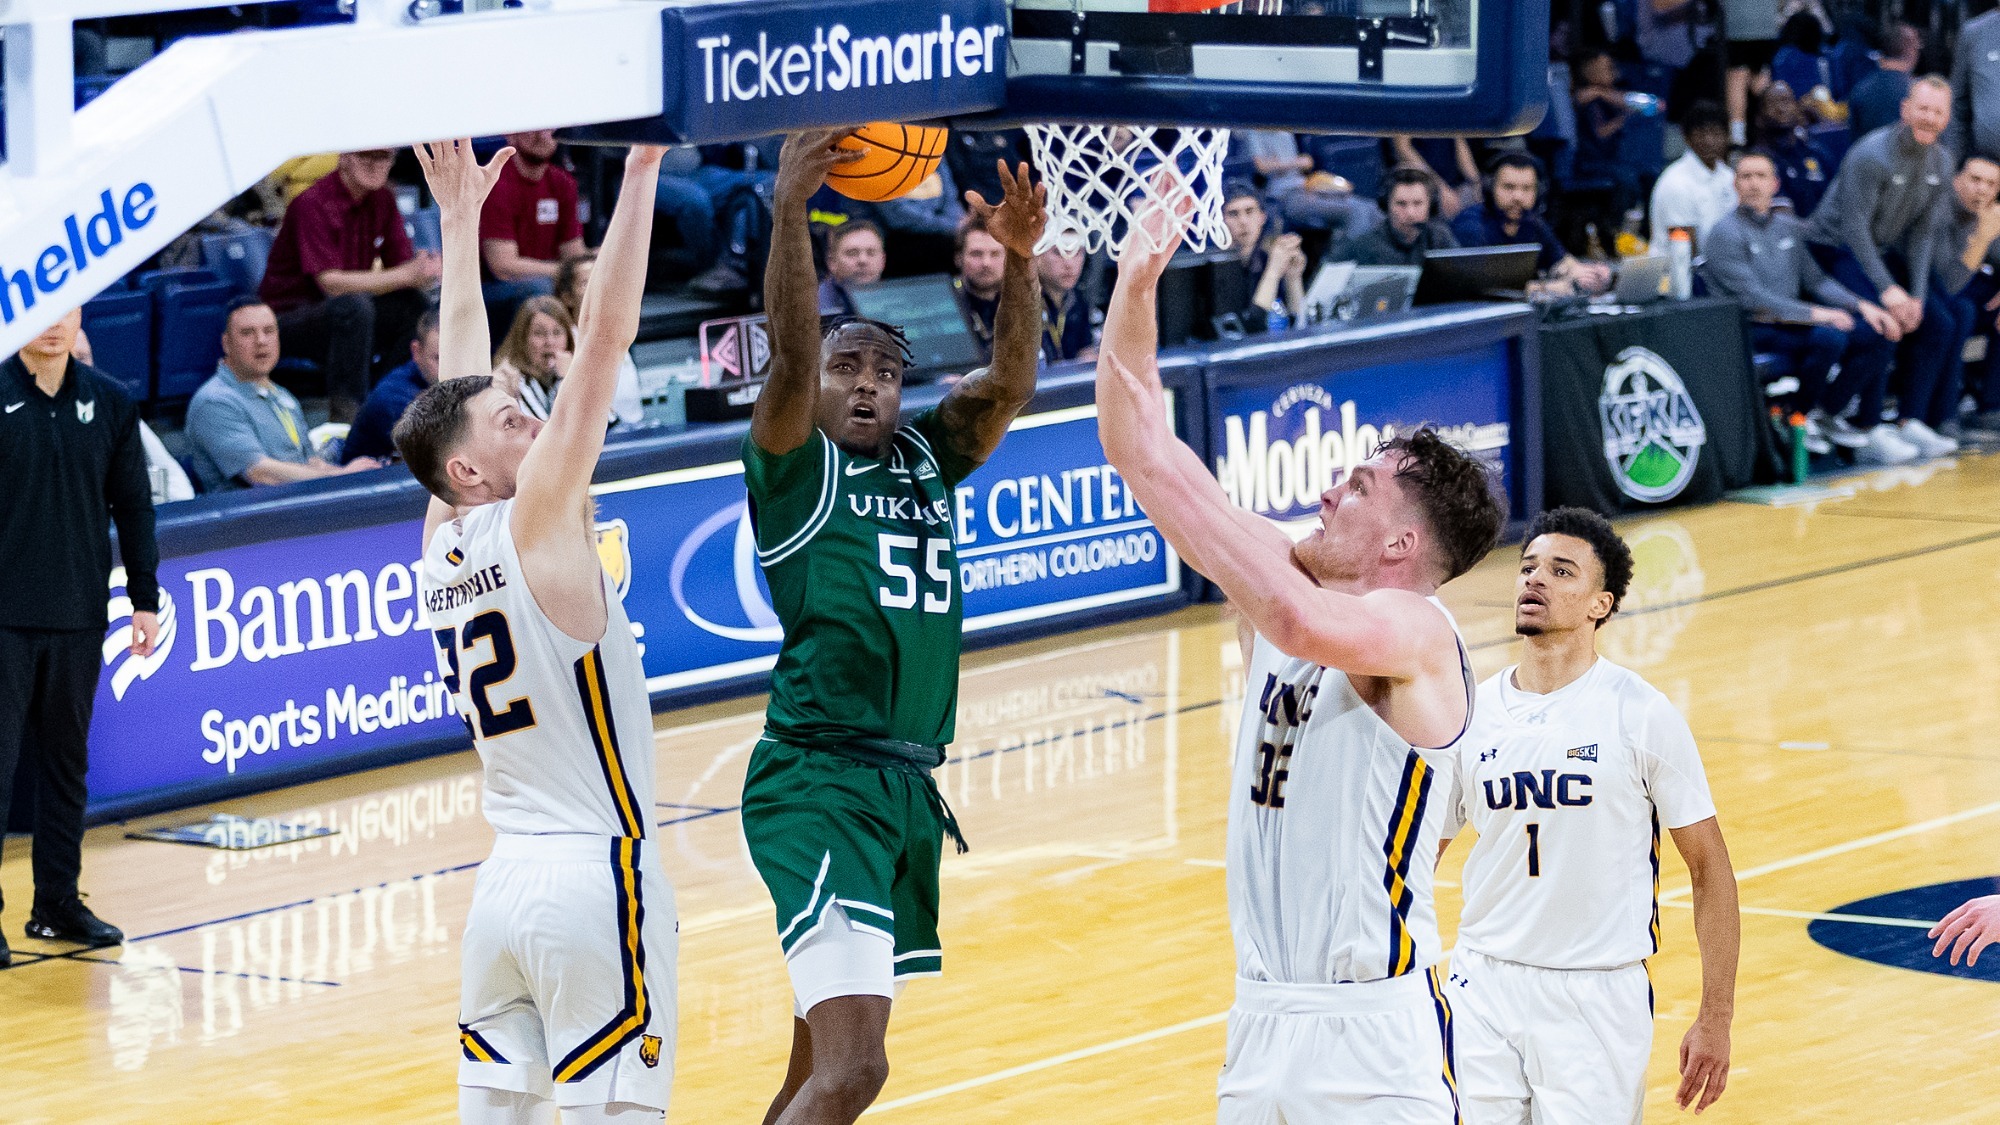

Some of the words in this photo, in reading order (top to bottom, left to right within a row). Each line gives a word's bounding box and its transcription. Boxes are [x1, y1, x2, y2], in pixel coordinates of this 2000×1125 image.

[698, 14, 1003, 103] TicketSmarter
[878, 533, 951, 613] 55
[1051, 531, 1157, 578] COLORADO
[201, 699, 322, 773] Sports
[1482, 769, 1593, 811] UNC
[1526, 823, 1540, 877] 1
